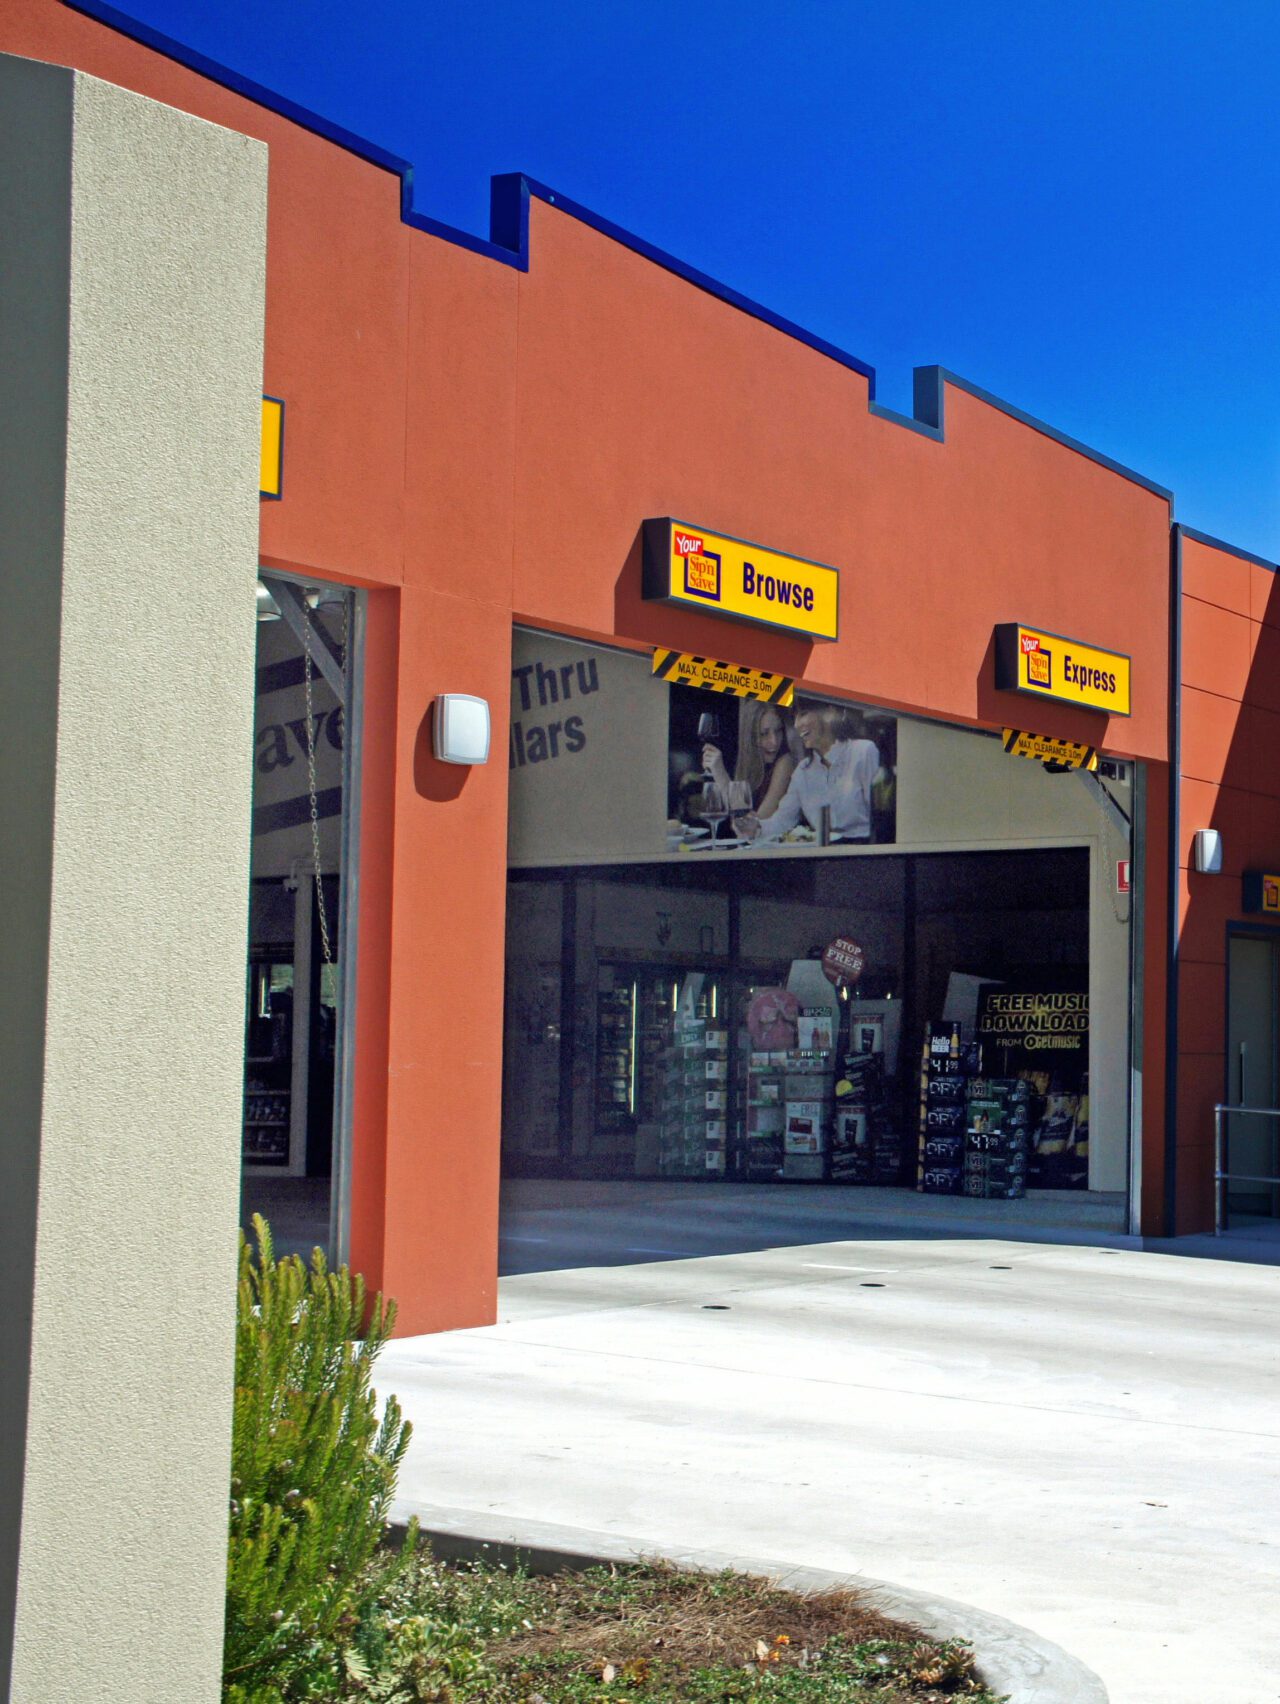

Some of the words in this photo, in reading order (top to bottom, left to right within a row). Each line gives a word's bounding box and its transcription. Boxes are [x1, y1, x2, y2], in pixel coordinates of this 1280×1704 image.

[676, 536, 702, 554] Your
[689, 556, 715, 577] Sip'n
[689, 572, 715, 591] Save
[743, 561, 814, 612] Browse
[1021, 637, 1039, 653] Your
[678, 662, 699, 677] MAX.
[701, 667, 751, 689] CLEARANCE
[753, 680, 772, 693] 3.0m
[1064, 655, 1116, 693] Express
[511, 658, 599, 712] Thru
[1034, 743, 1068, 758] CLEARANCE
[836, 938, 862, 955] STOP
[826, 948, 863, 970] FREE
[988, 994, 1034, 1012] FREE
[932, 1036, 950, 1046] Hello
[996, 1038, 1021, 1048] FROM
[930, 1081, 962, 1096] DRY
[928, 1112, 960, 1126] DRY
[926, 1142, 959, 1156] DRY
